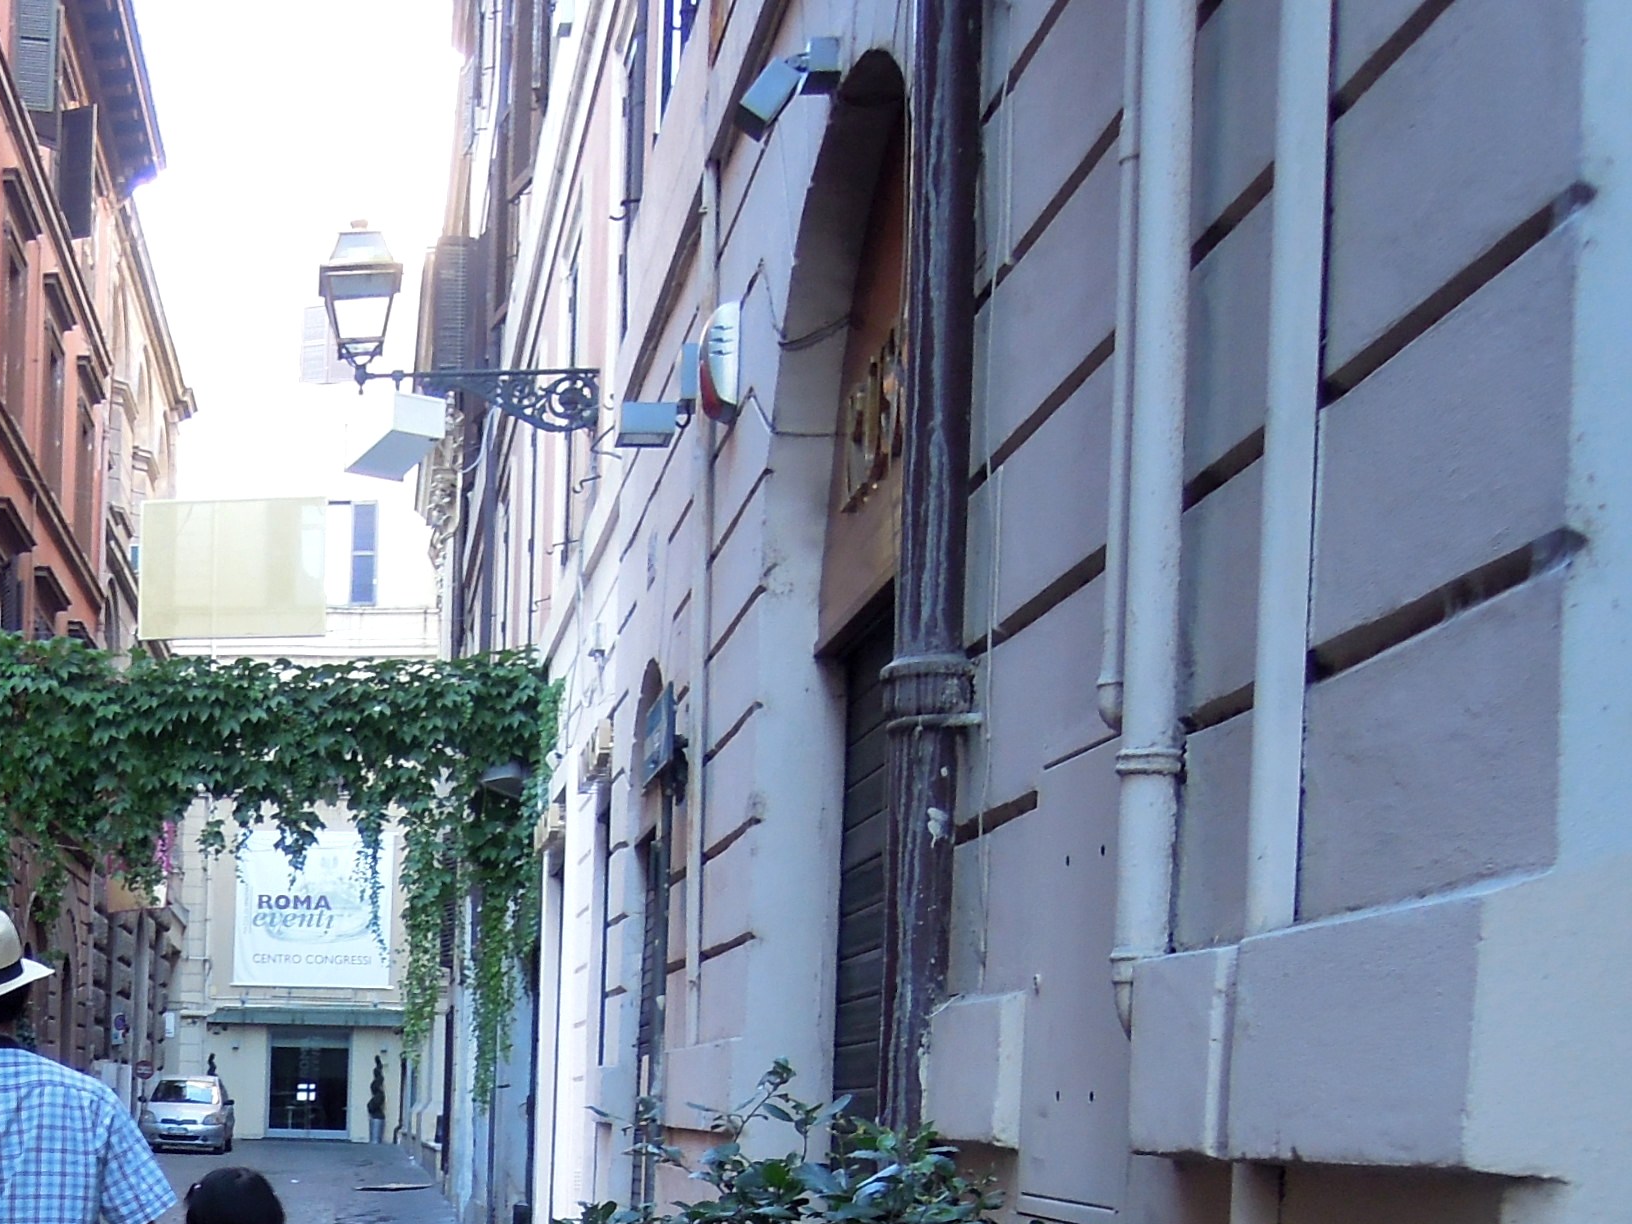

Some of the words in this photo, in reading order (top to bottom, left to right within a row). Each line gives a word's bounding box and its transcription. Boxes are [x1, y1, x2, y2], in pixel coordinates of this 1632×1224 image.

[257, 894, 333, 911] ROMA
[252, 909, 335, 930] eventi
[252, 953, 303, 965] CENTRO
[305, 953, 372, 966] CONGRESSI
